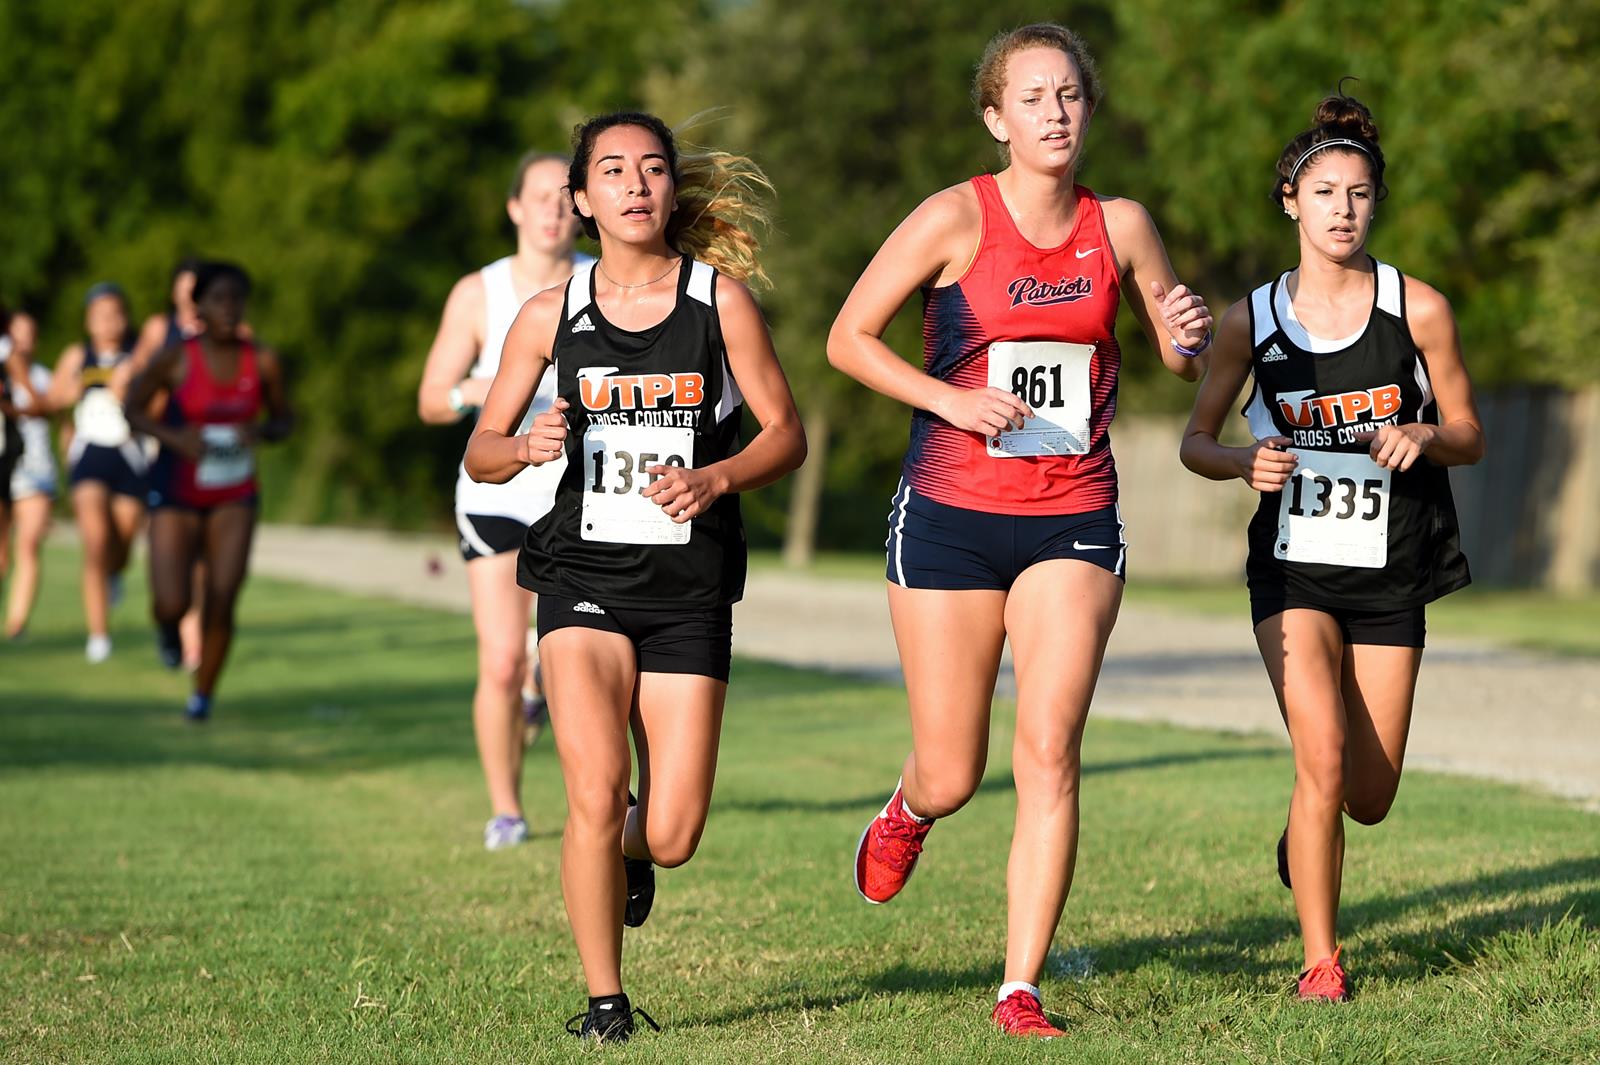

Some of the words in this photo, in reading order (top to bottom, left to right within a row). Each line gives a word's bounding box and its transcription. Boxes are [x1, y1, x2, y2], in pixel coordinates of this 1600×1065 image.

[1007, 275, 1093, 309] Patriots
[1262, 353, 1288, 362] adidas
[577, 367, 705, 411] UTPB
[1011, 364, 1065, 409] 861
[1276, 384, 1402, 428] UTPB
[587, 412, 629, 426] CROSS
[635, 409, 702, 427] COUNTRY
[1293, 430, 1332, 447] CROSS
[592, 450, 686, 494] 135
[1288, 473, 1383, 521] 1335
[573, 603, 605, 614] adidas
